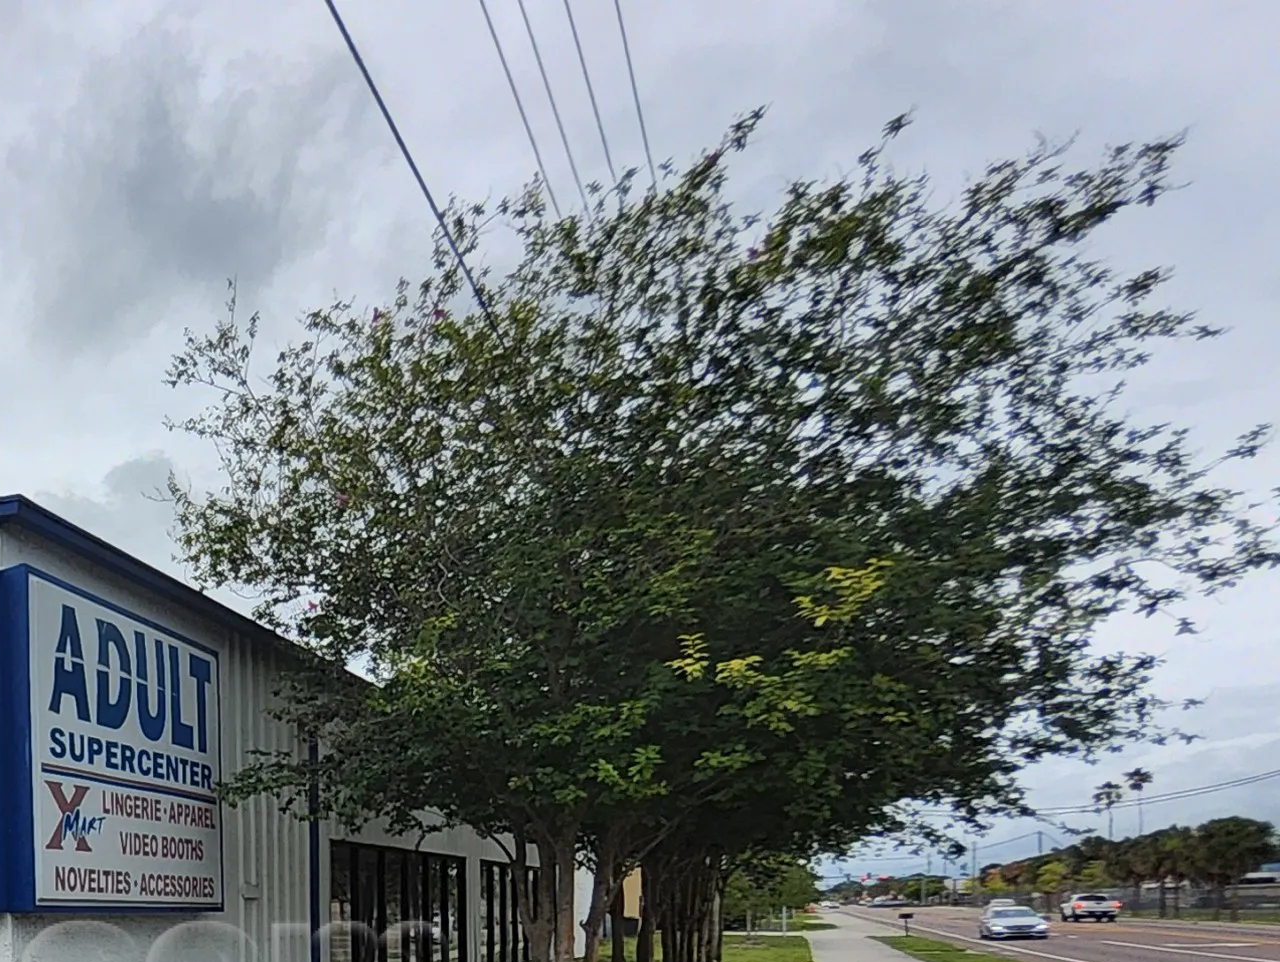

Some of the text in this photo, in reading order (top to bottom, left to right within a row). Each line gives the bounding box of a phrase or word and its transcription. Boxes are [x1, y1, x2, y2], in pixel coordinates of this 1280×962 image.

[48, 603, 211, 754] ADULT
[49, 727, 213, 790] SUPERCENTER
[102, 790, 216, 830] LINGERIE APPAREL
[119, 831, 204, 861] VIDEO BOOTHS
[54, 866, 215, 899] NOVELTIES ACCESSORIES
